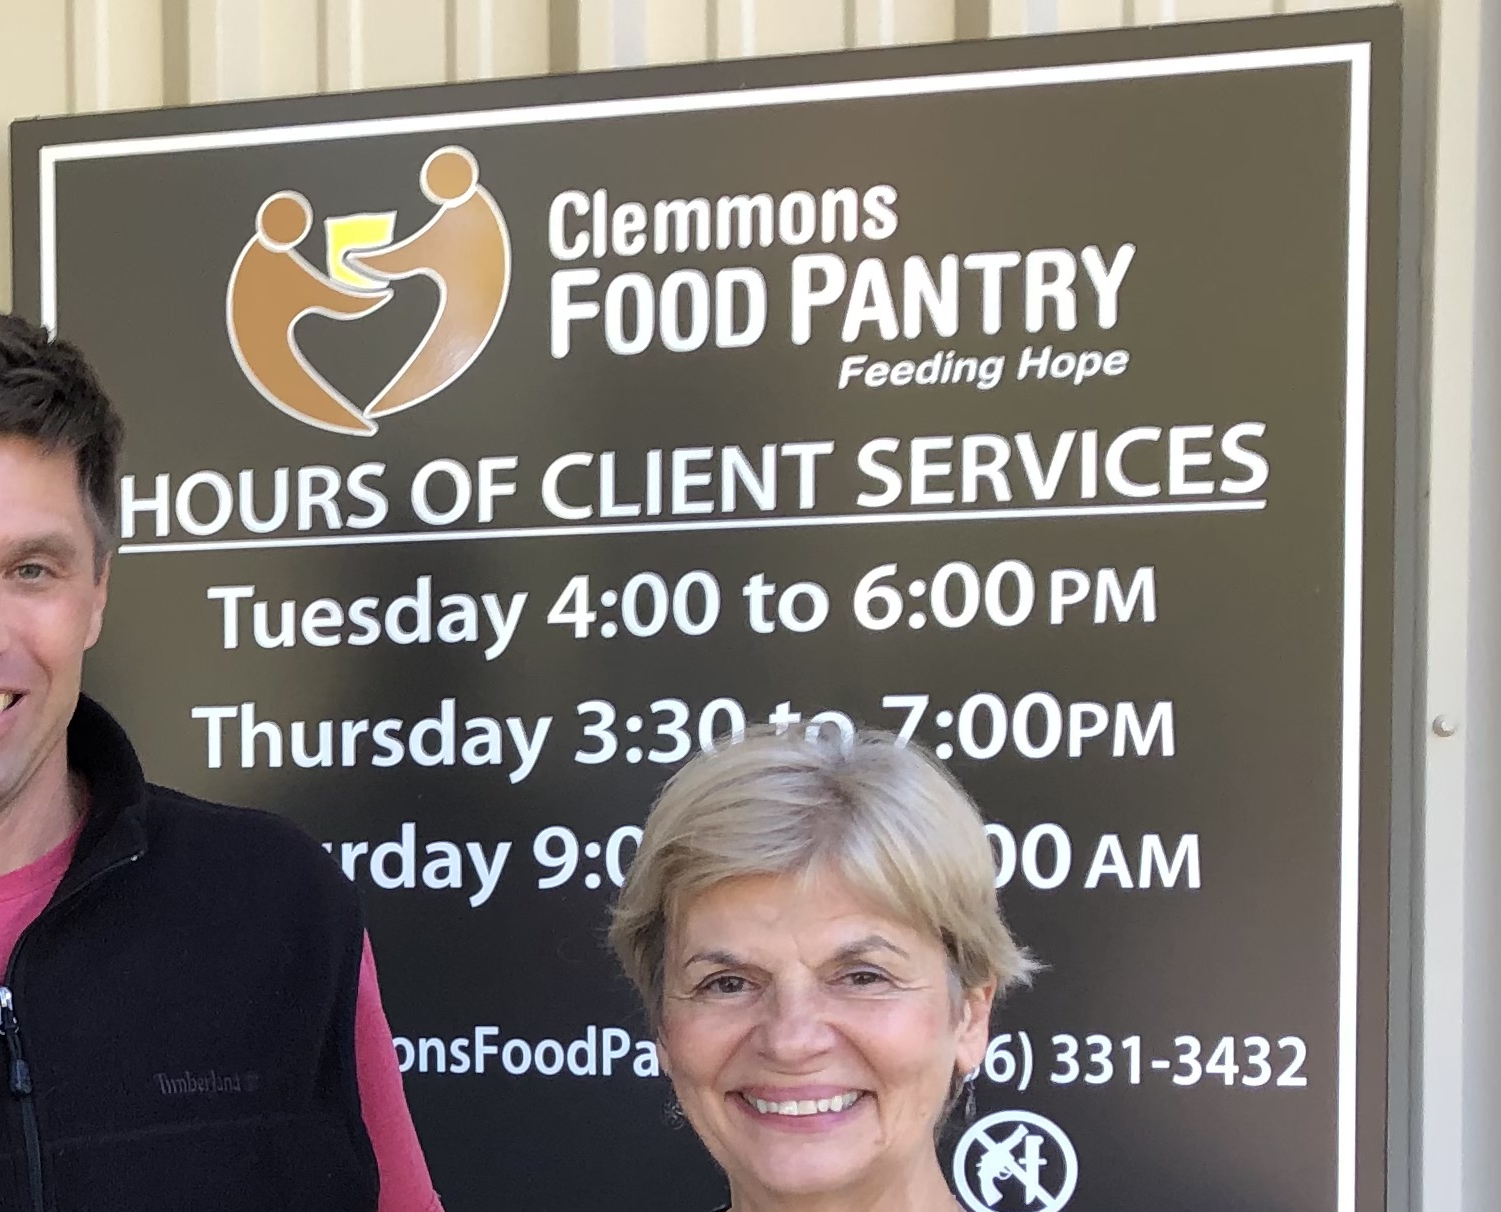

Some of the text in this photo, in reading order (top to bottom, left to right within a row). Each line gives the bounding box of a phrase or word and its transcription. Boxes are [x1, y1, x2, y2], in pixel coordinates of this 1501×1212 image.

[548, 184, 898, 261] Clemmons
[550, 242, 1137, 359] FOOD PANTRY
[837, 345, 1130, 390] Feeding Hope
[119, 421, 1270, 538] HOURS OF CLIENT SERVICES
[207, 560, 1158, 661] Tuesday 4:00 to 6:00 PM
[191, 698, 554, 784] Thursday
[574, 697, 746, 764] 3:30
[769, 700, 856, 758] to
[322, 822, 1202, 908] rday 9:0 00 AM
[392, 1025, 1309, 1091] onsFoodPa 6) 331-3432
